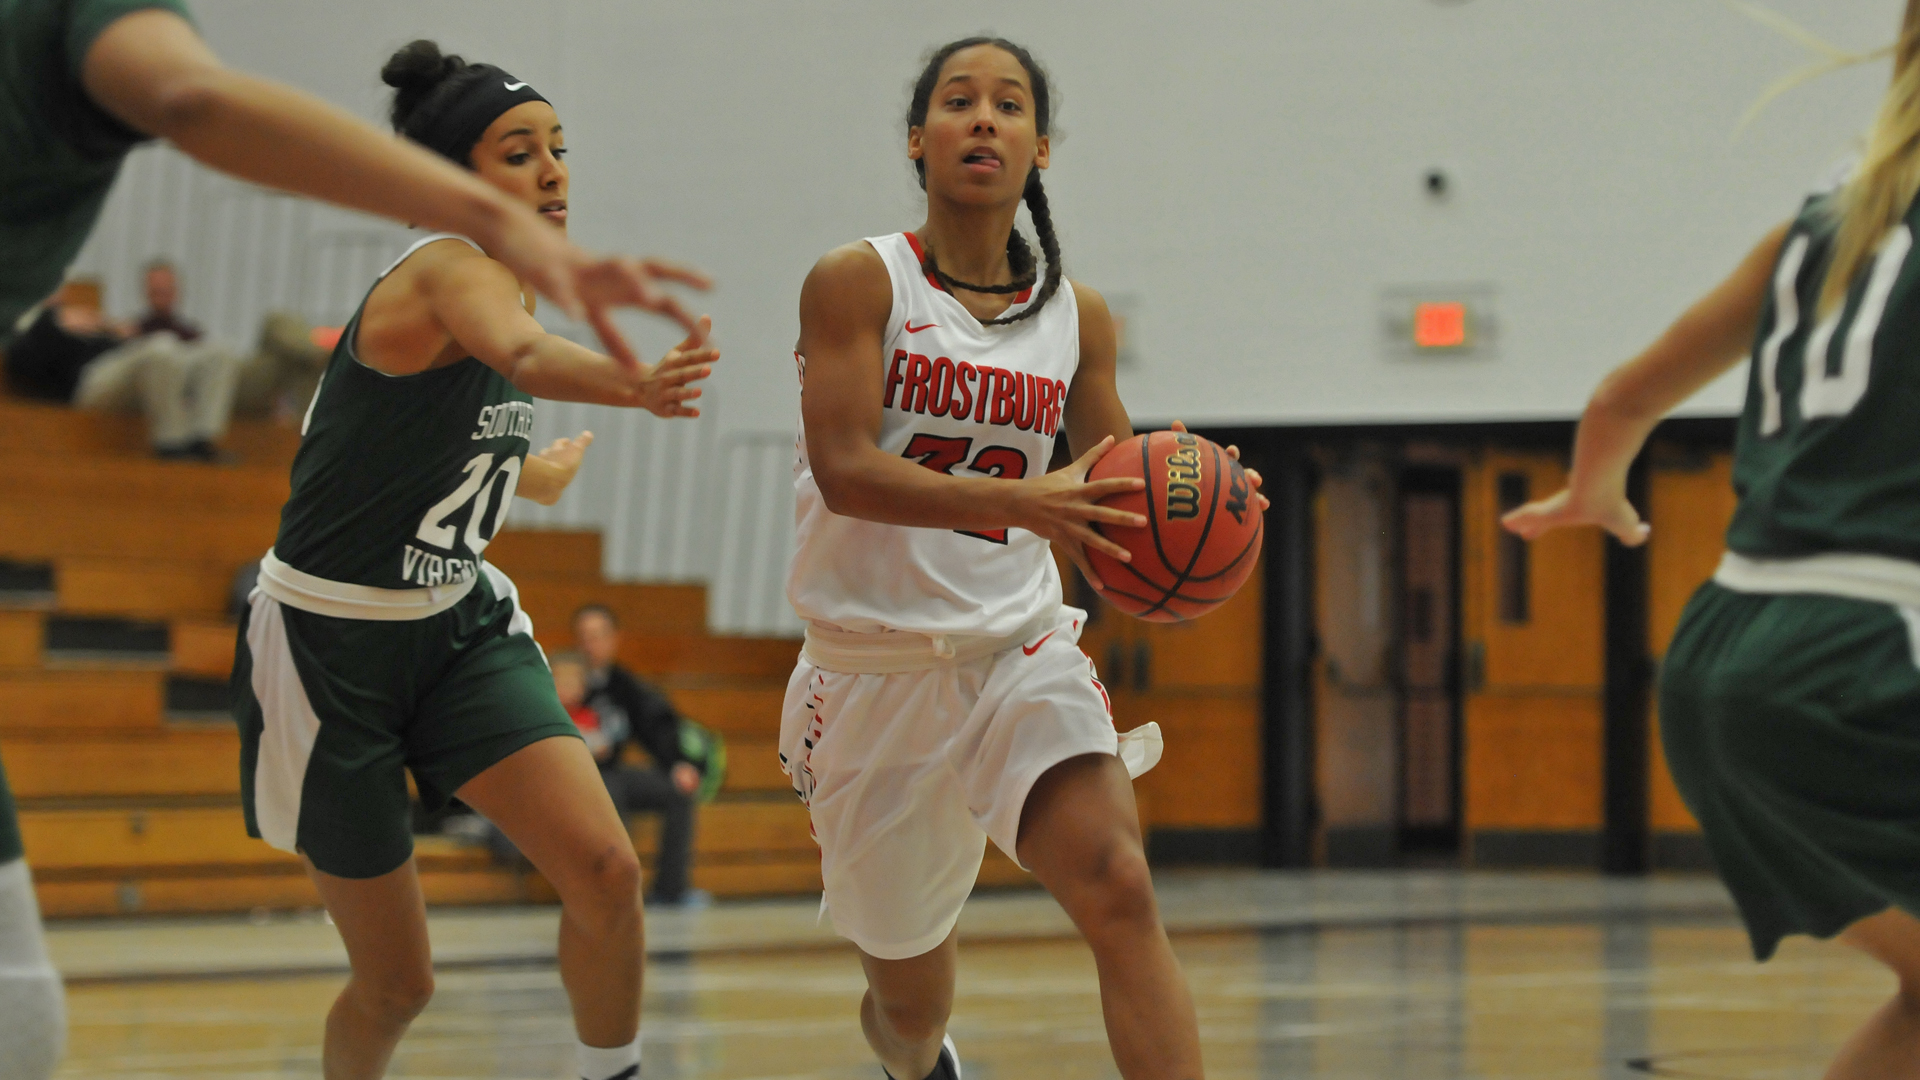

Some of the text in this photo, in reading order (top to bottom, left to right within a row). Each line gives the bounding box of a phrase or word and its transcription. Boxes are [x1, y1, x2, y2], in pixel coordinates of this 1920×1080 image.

[1759, 224, 1912, 435] 10
[884, 349, 1066, 438] FROSTBURG
[415, 453, 521, 554] 20
